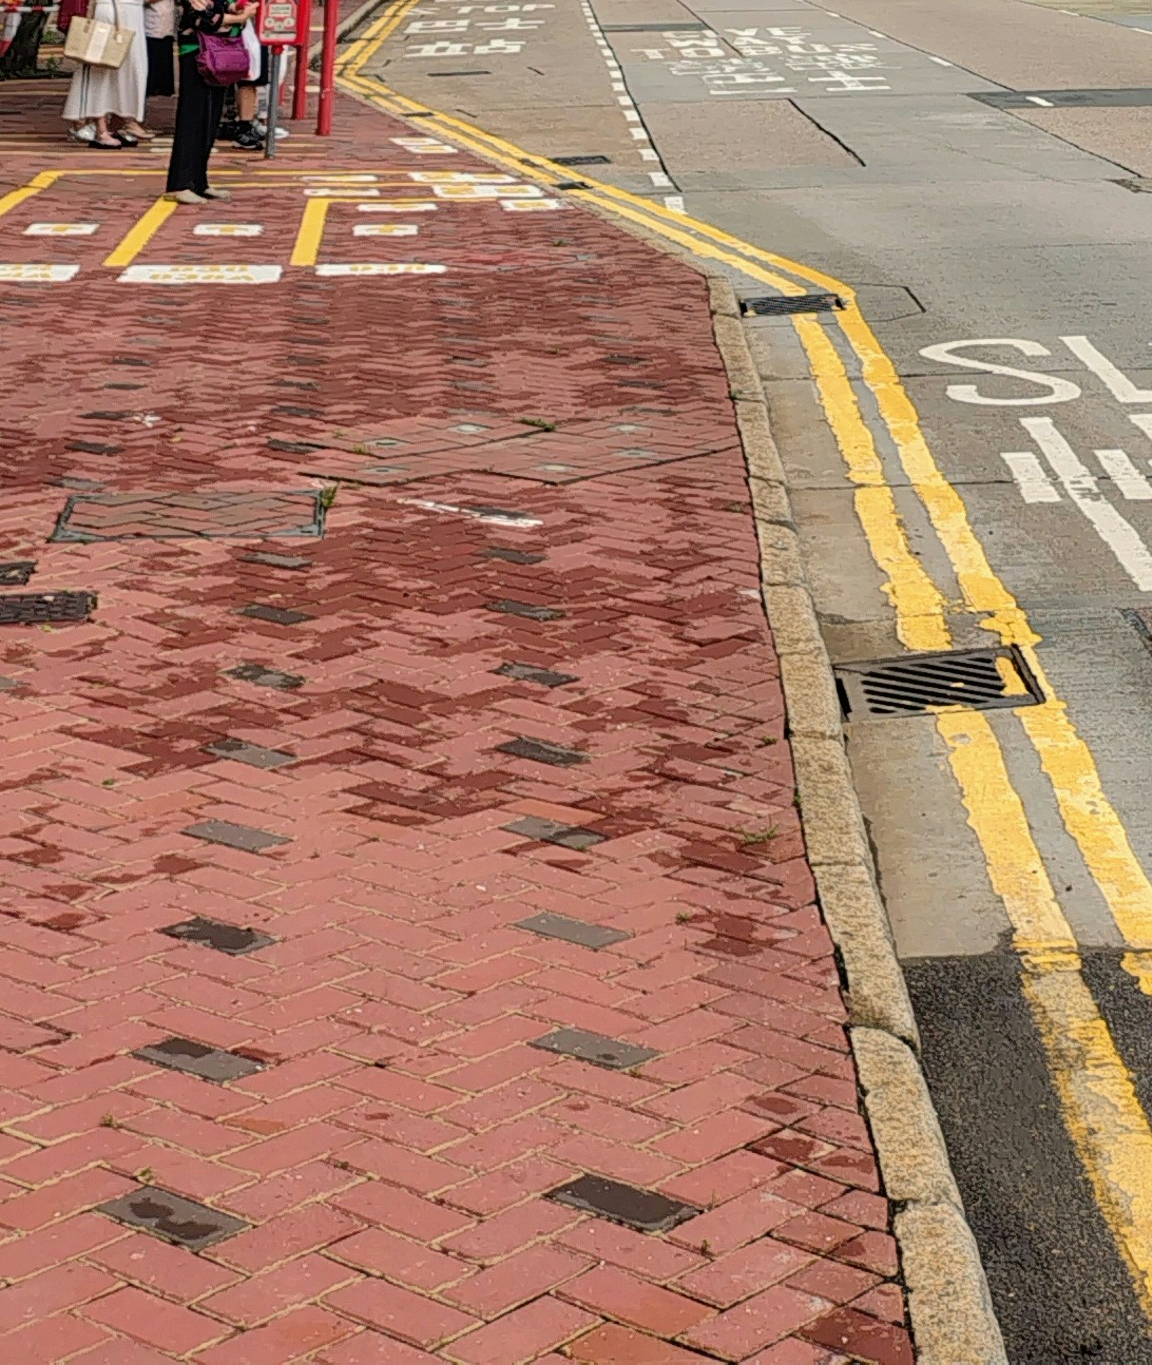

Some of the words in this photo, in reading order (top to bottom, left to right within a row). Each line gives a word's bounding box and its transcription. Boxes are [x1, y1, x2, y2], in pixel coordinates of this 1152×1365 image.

[403, 17, 546, 34] 巴士
[630, 47, 726, 59] TO
[700, 70, 892, 95] 巴士
